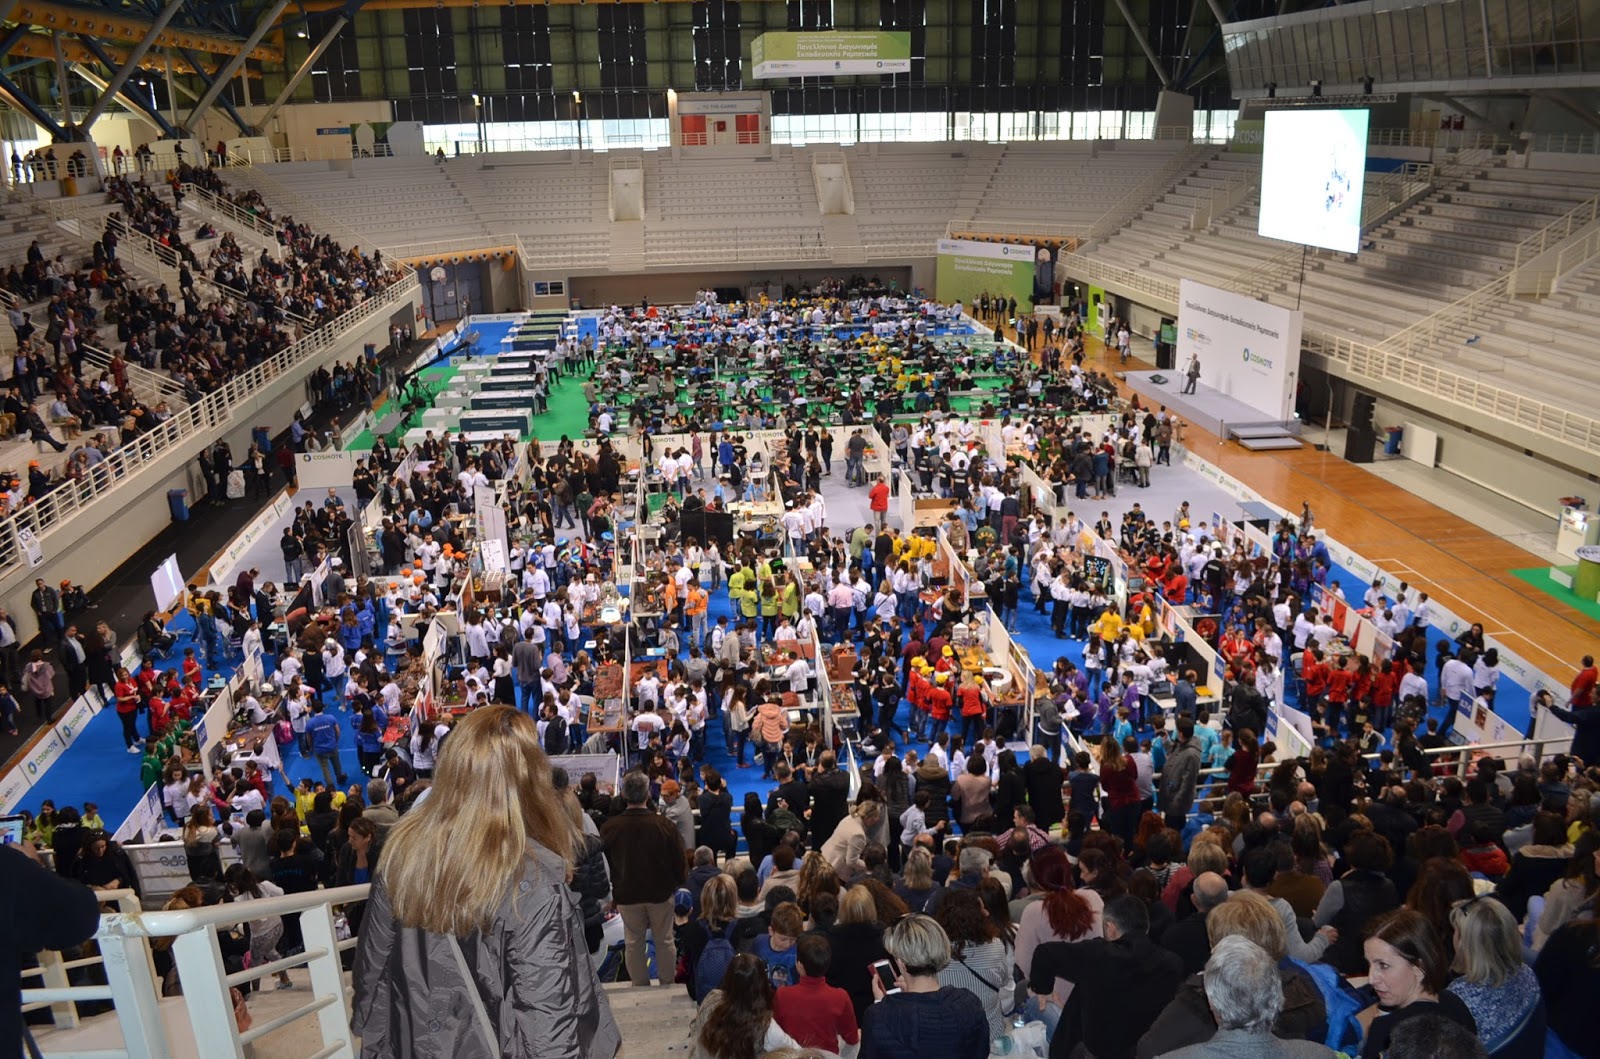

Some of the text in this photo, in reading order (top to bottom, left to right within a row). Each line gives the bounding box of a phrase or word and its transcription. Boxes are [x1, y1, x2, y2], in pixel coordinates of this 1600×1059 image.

[797, 43, 878, 51] Πανελλήνιος Διαγωνισμός
[650, 436, 675, 444] OSMOTE
[69, 706, 88, 729] COSMOTE
[35, 740, 59, 766] COSMOTE
